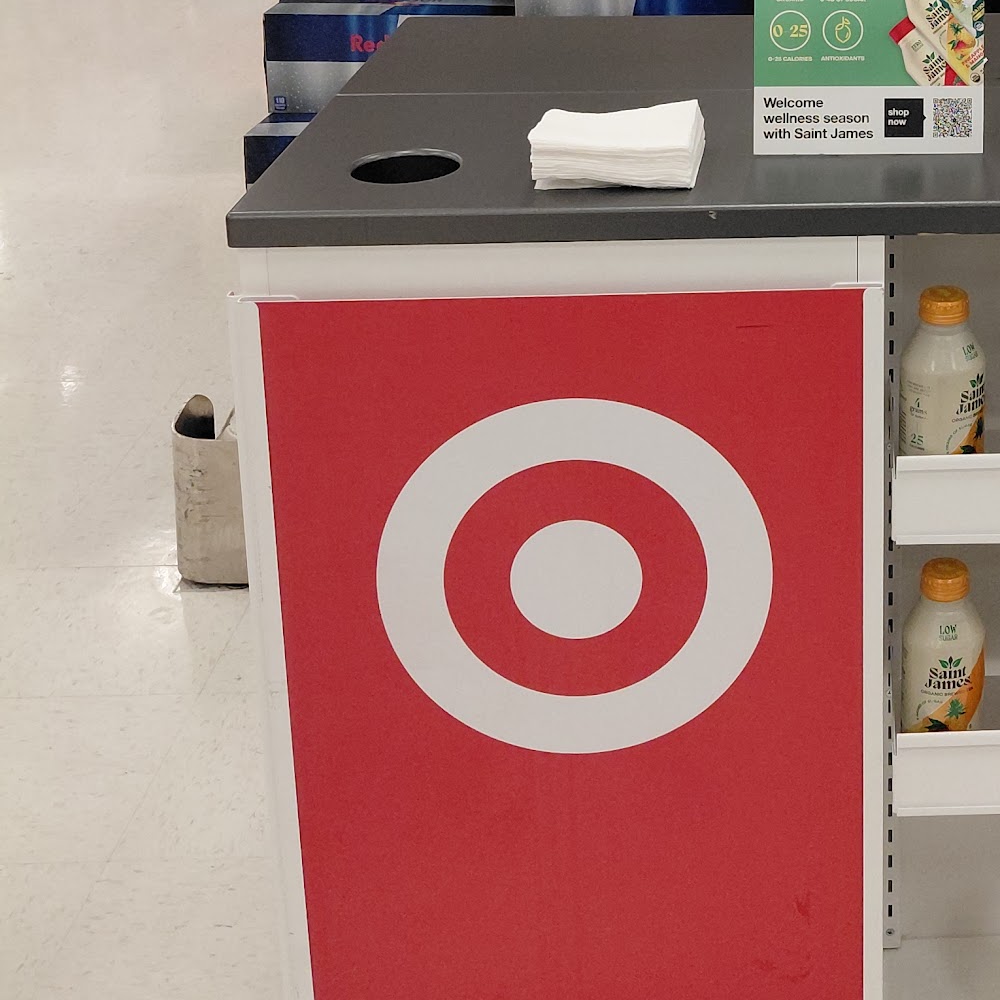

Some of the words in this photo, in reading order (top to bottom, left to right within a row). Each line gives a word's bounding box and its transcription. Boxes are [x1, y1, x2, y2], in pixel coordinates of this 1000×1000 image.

[763, 98, 824, 108] Welcome
[888, 108, 909, 117] shop
[763, 113, 820, 123] wellness
[824, 115, 869, 123] season
[888, 118, 907, 126] now
[764, 128, 790, 139] with
[794, 128, 827, 139] Saint
[831, 128, 873, 139] James
[939, 624, 957, 635] LOW
[929, 666, 967, 680] Saint
[925, 676, 972, 690] James
